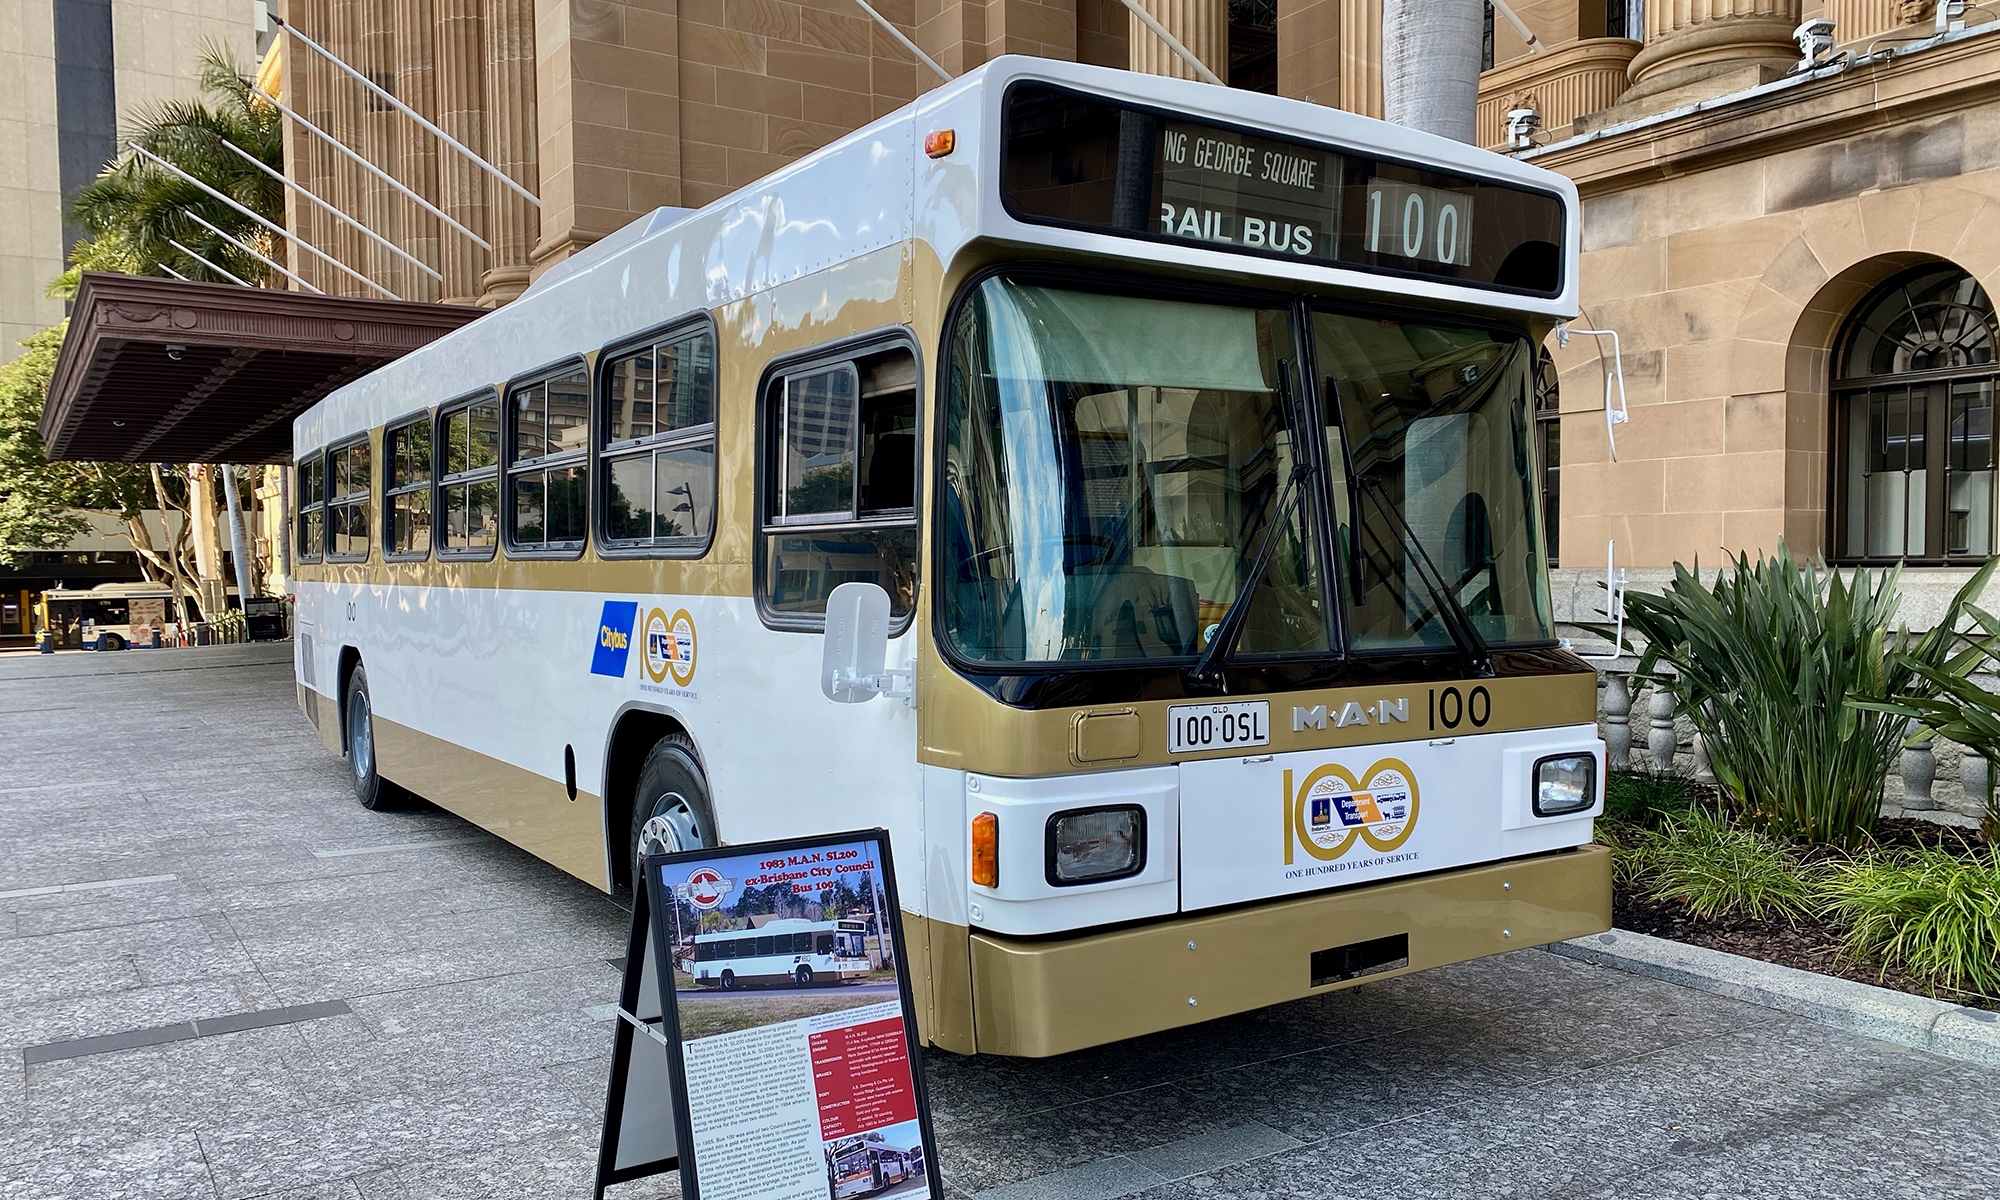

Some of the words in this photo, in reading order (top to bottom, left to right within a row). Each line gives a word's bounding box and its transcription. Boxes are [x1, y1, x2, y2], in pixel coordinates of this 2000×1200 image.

[1194, 137, 1255, 177] GEORGE
[1261, 151, 1317, 190] SQUARE
[1244, 216, 1313, 256] BUS
[1371, 190, 1458, 264] 100
[600, 625, 628, 652] Citybus
[1429, 686, 1491, 731] 100
[1283, 758, 1420, 865] 100
[1342, 798, 1370, 809] Department
[1345, 811, 1368, 820] Transport
[745, 871, 807, 886] ex-Brisbane
[810, 867, 832, 877] City
[835, 861, 874, 874] Council
[760, 860, 785, 870] 1983
[788, 853, 824, 866] M.A.N.
[826, 850, 857, 861] SL200
[1285, 870, 1304, 879] ONE
[1305, 864, 1345, 876] HUNDRED
[1347, 859, 1373, 870] YEARS
[1375, 856, 1385, 865] OF
[1386, 852, 1419, 863] SERVICE
[792, 884, 812, 894] Bus
[816, 881, 834, 891] 100
